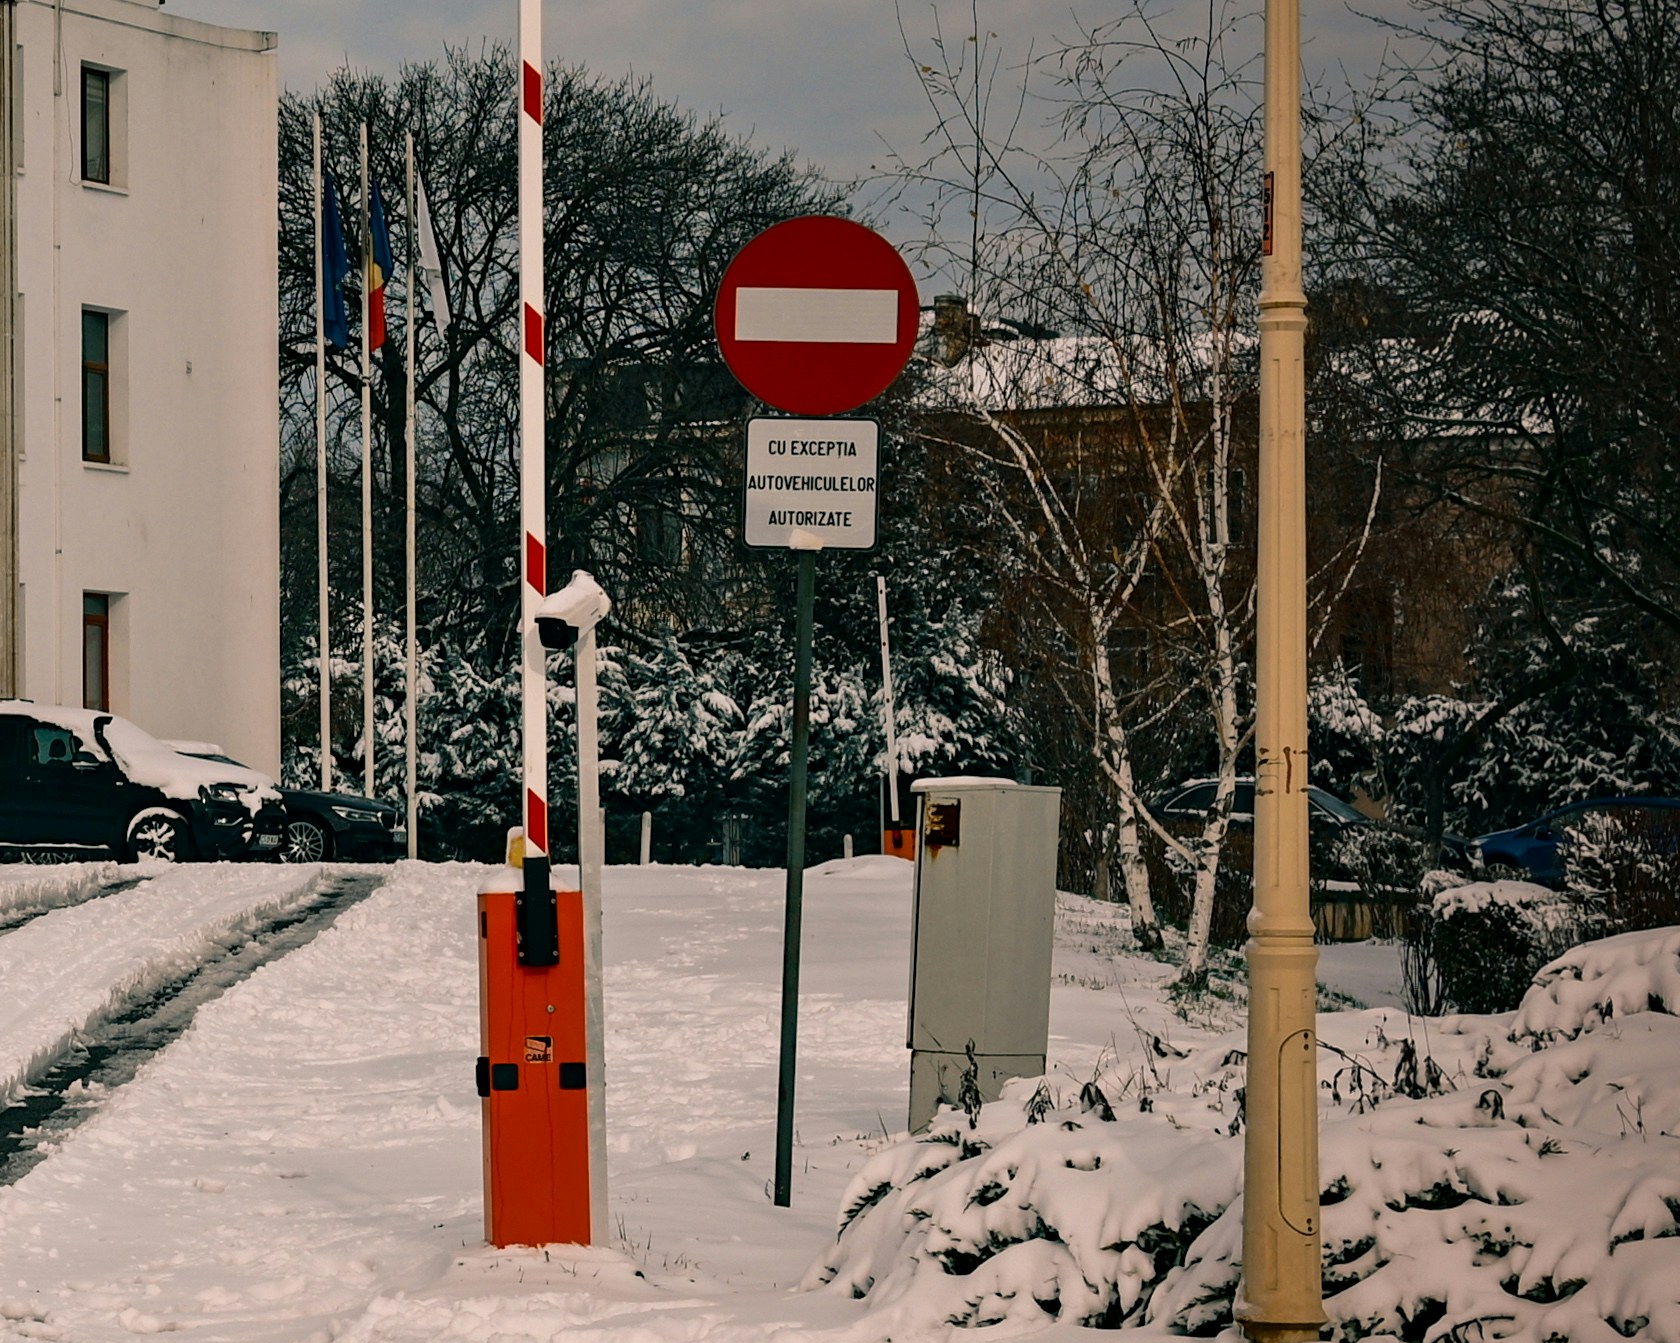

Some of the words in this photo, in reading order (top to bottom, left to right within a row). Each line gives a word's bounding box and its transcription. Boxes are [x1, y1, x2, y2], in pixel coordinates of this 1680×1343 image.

[768, 440, 786, 455] CU
[791, 440, 857, 459] EXCEPȚIA
[748, 475, 875, 492] AUTOVEHICULELOR
[768, 510, 852, 527] AUTORIZATE
[525, 1053, 551, 1062] CAME
